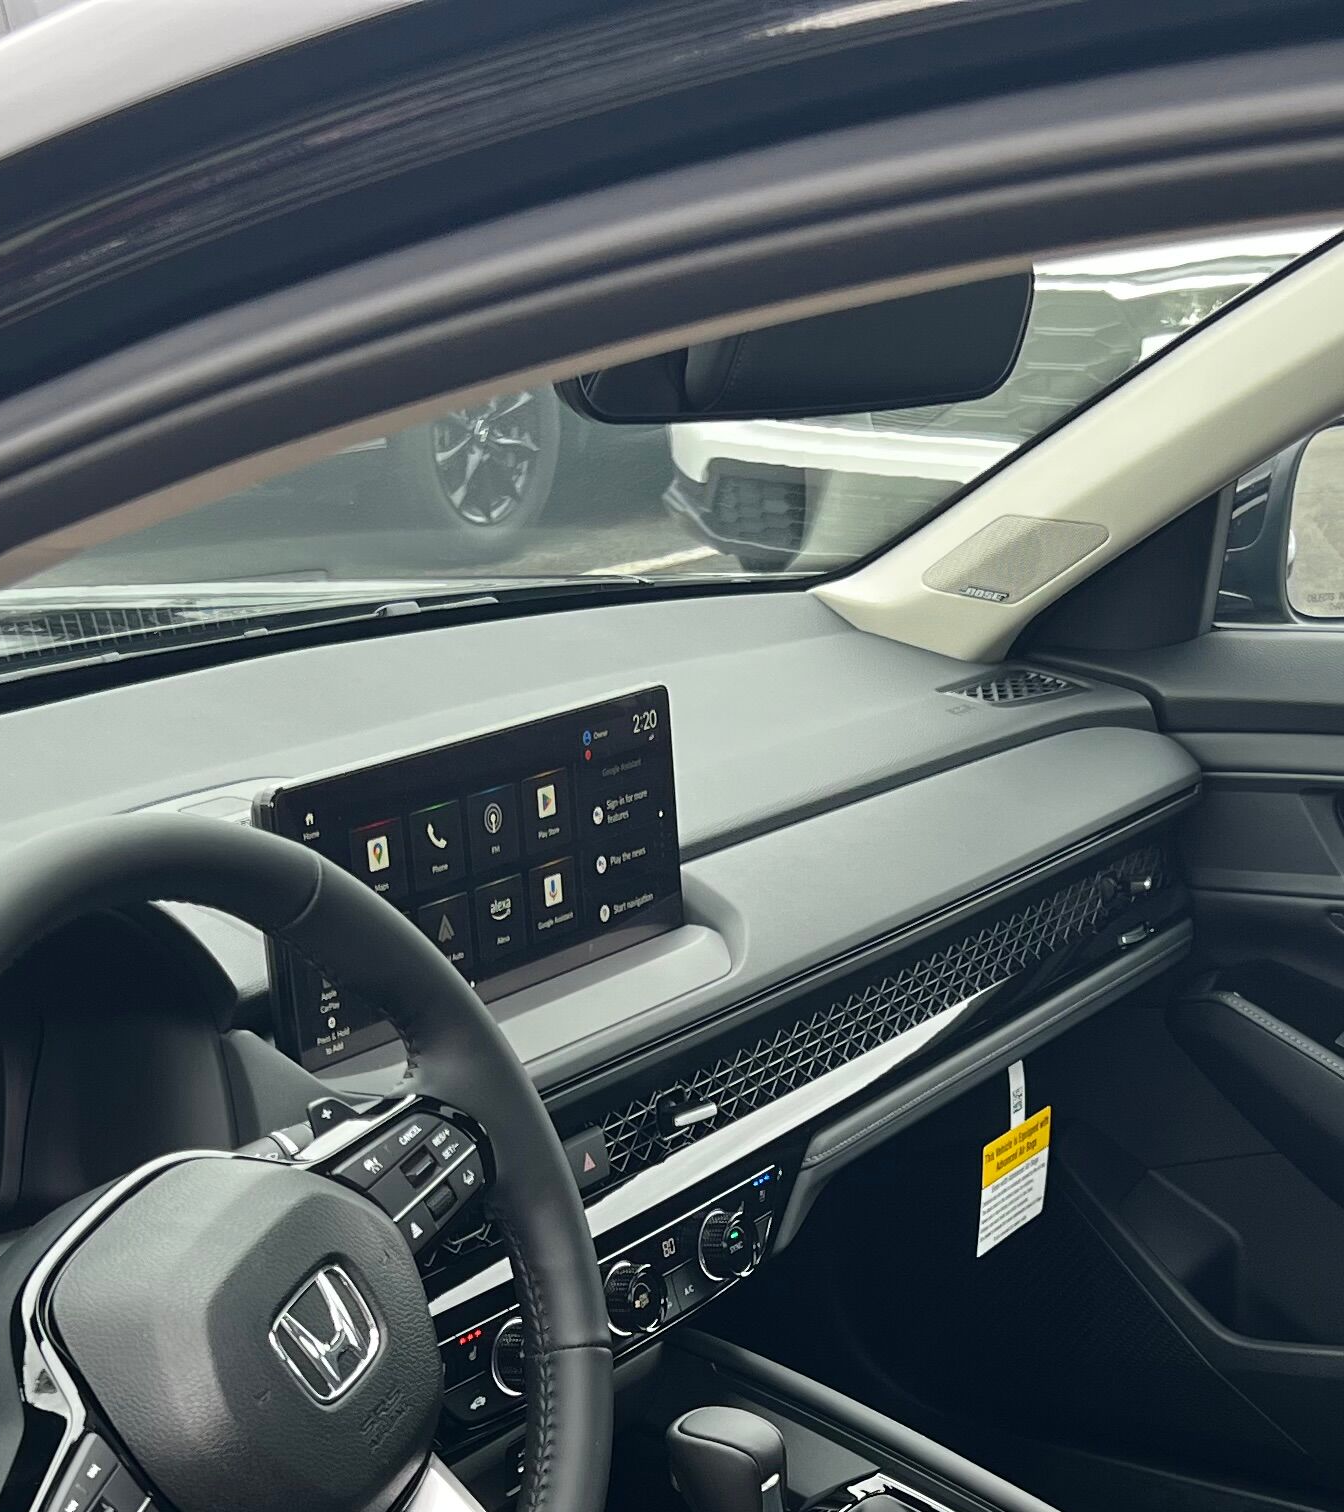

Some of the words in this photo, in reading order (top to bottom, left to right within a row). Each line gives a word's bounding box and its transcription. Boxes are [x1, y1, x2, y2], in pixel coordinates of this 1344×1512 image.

[632, 709, 657, 733] 2:20
[607, 809, 629, 824] features
[609, 853, 622, 867] Play
[622, 850, 632, 862] the
[632, 847, 646, 858] news
[432, 863, 449, 874] Phone
[490, 898, 511, 914] alexa
[627, 892, 654, 912] navigation
[399, 1125, 422, 1145] CANCEL
[662, 1238, 676, 1258] 80
[729, 1241, 744, 1254] SYNC
